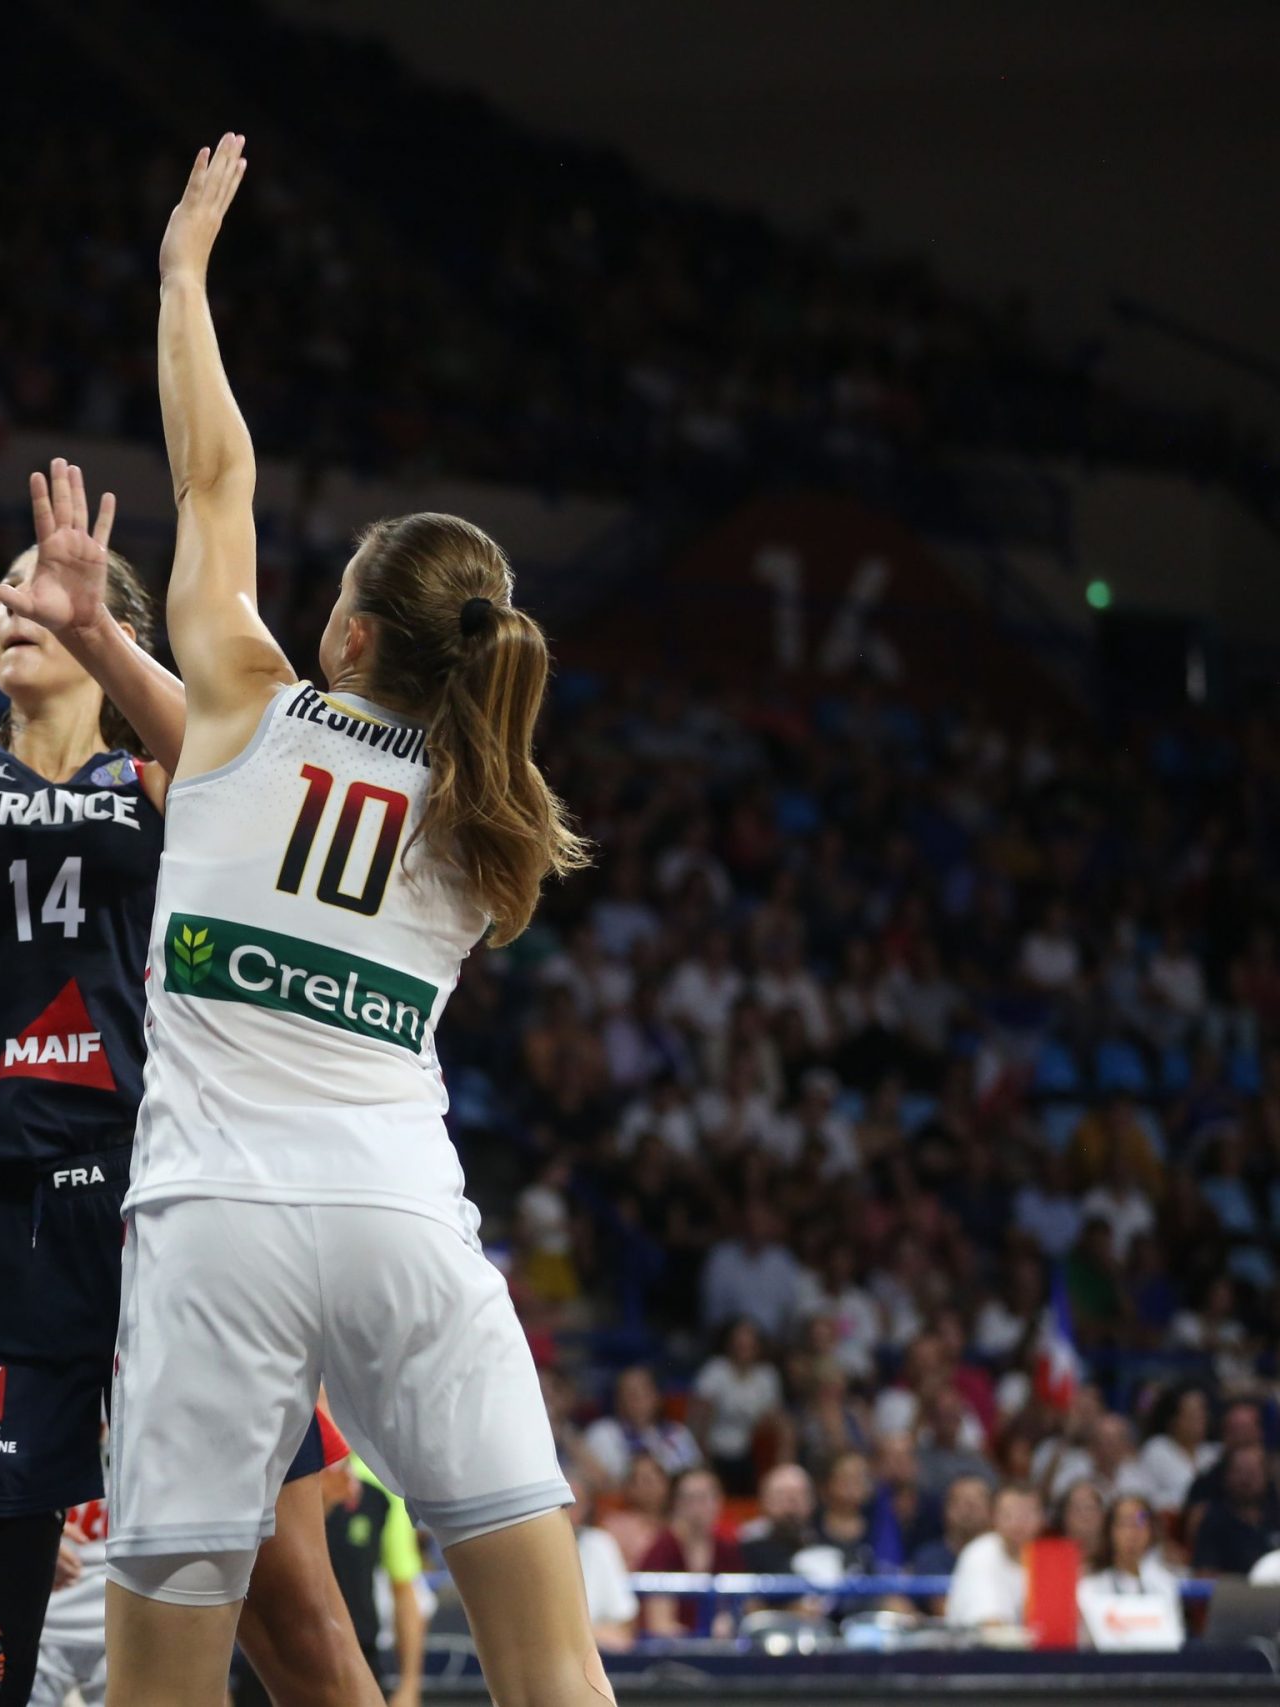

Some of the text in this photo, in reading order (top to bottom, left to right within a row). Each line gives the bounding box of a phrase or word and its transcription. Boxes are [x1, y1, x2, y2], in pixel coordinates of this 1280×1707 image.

[275, 763, 410, 917] 10
[8, 856, 87, 942] 14
[228, 944, 421, 1041] Crelan
[4, 1032, 102, 1067] MAIF
[53, 1166, 106, 1190] FRA
